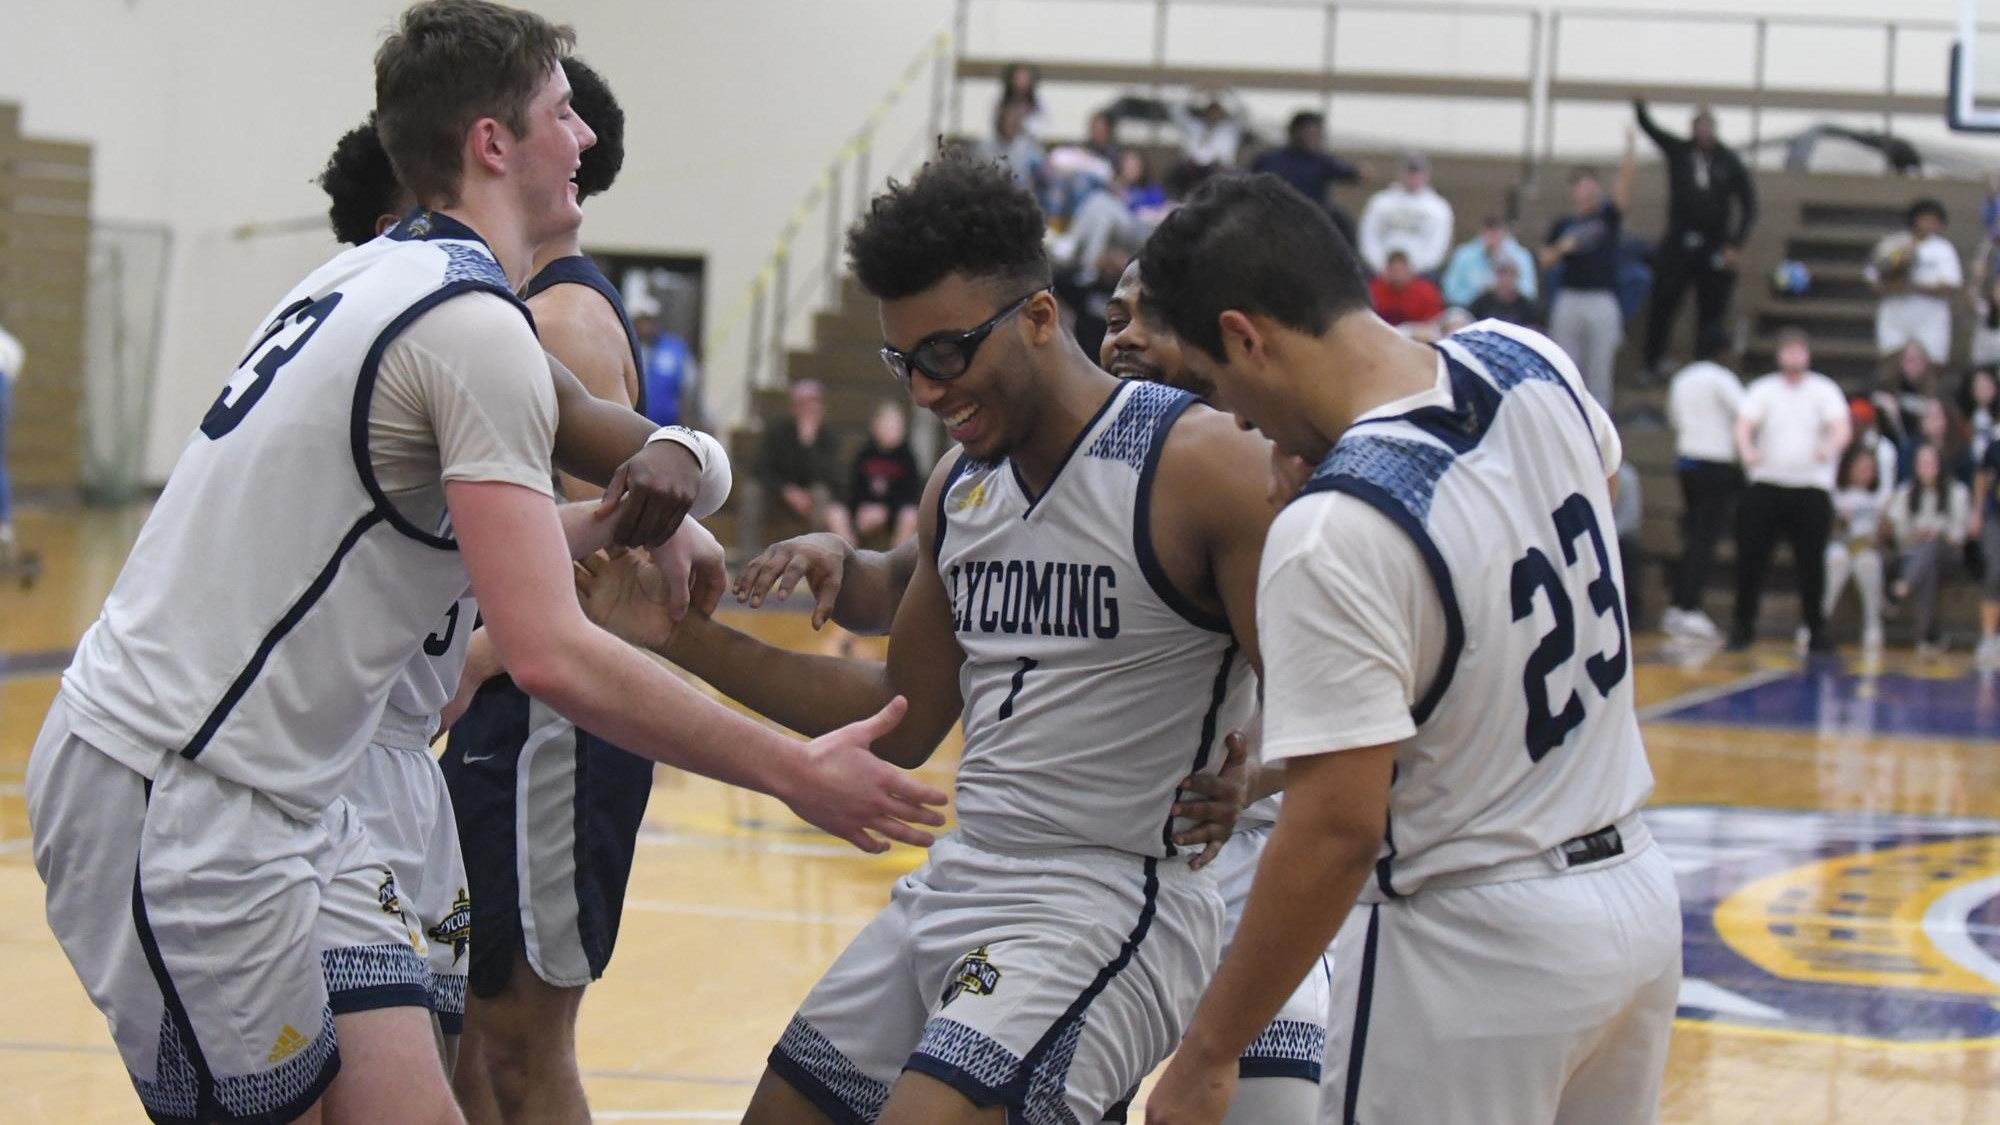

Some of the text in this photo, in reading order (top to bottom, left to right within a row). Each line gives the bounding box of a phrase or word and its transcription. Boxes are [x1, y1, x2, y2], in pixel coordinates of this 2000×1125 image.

[200, 292, 343, 440] 3
[950, 560, 1120, 639] LYCOMING
[1510, 492, 1627, 763] 23
